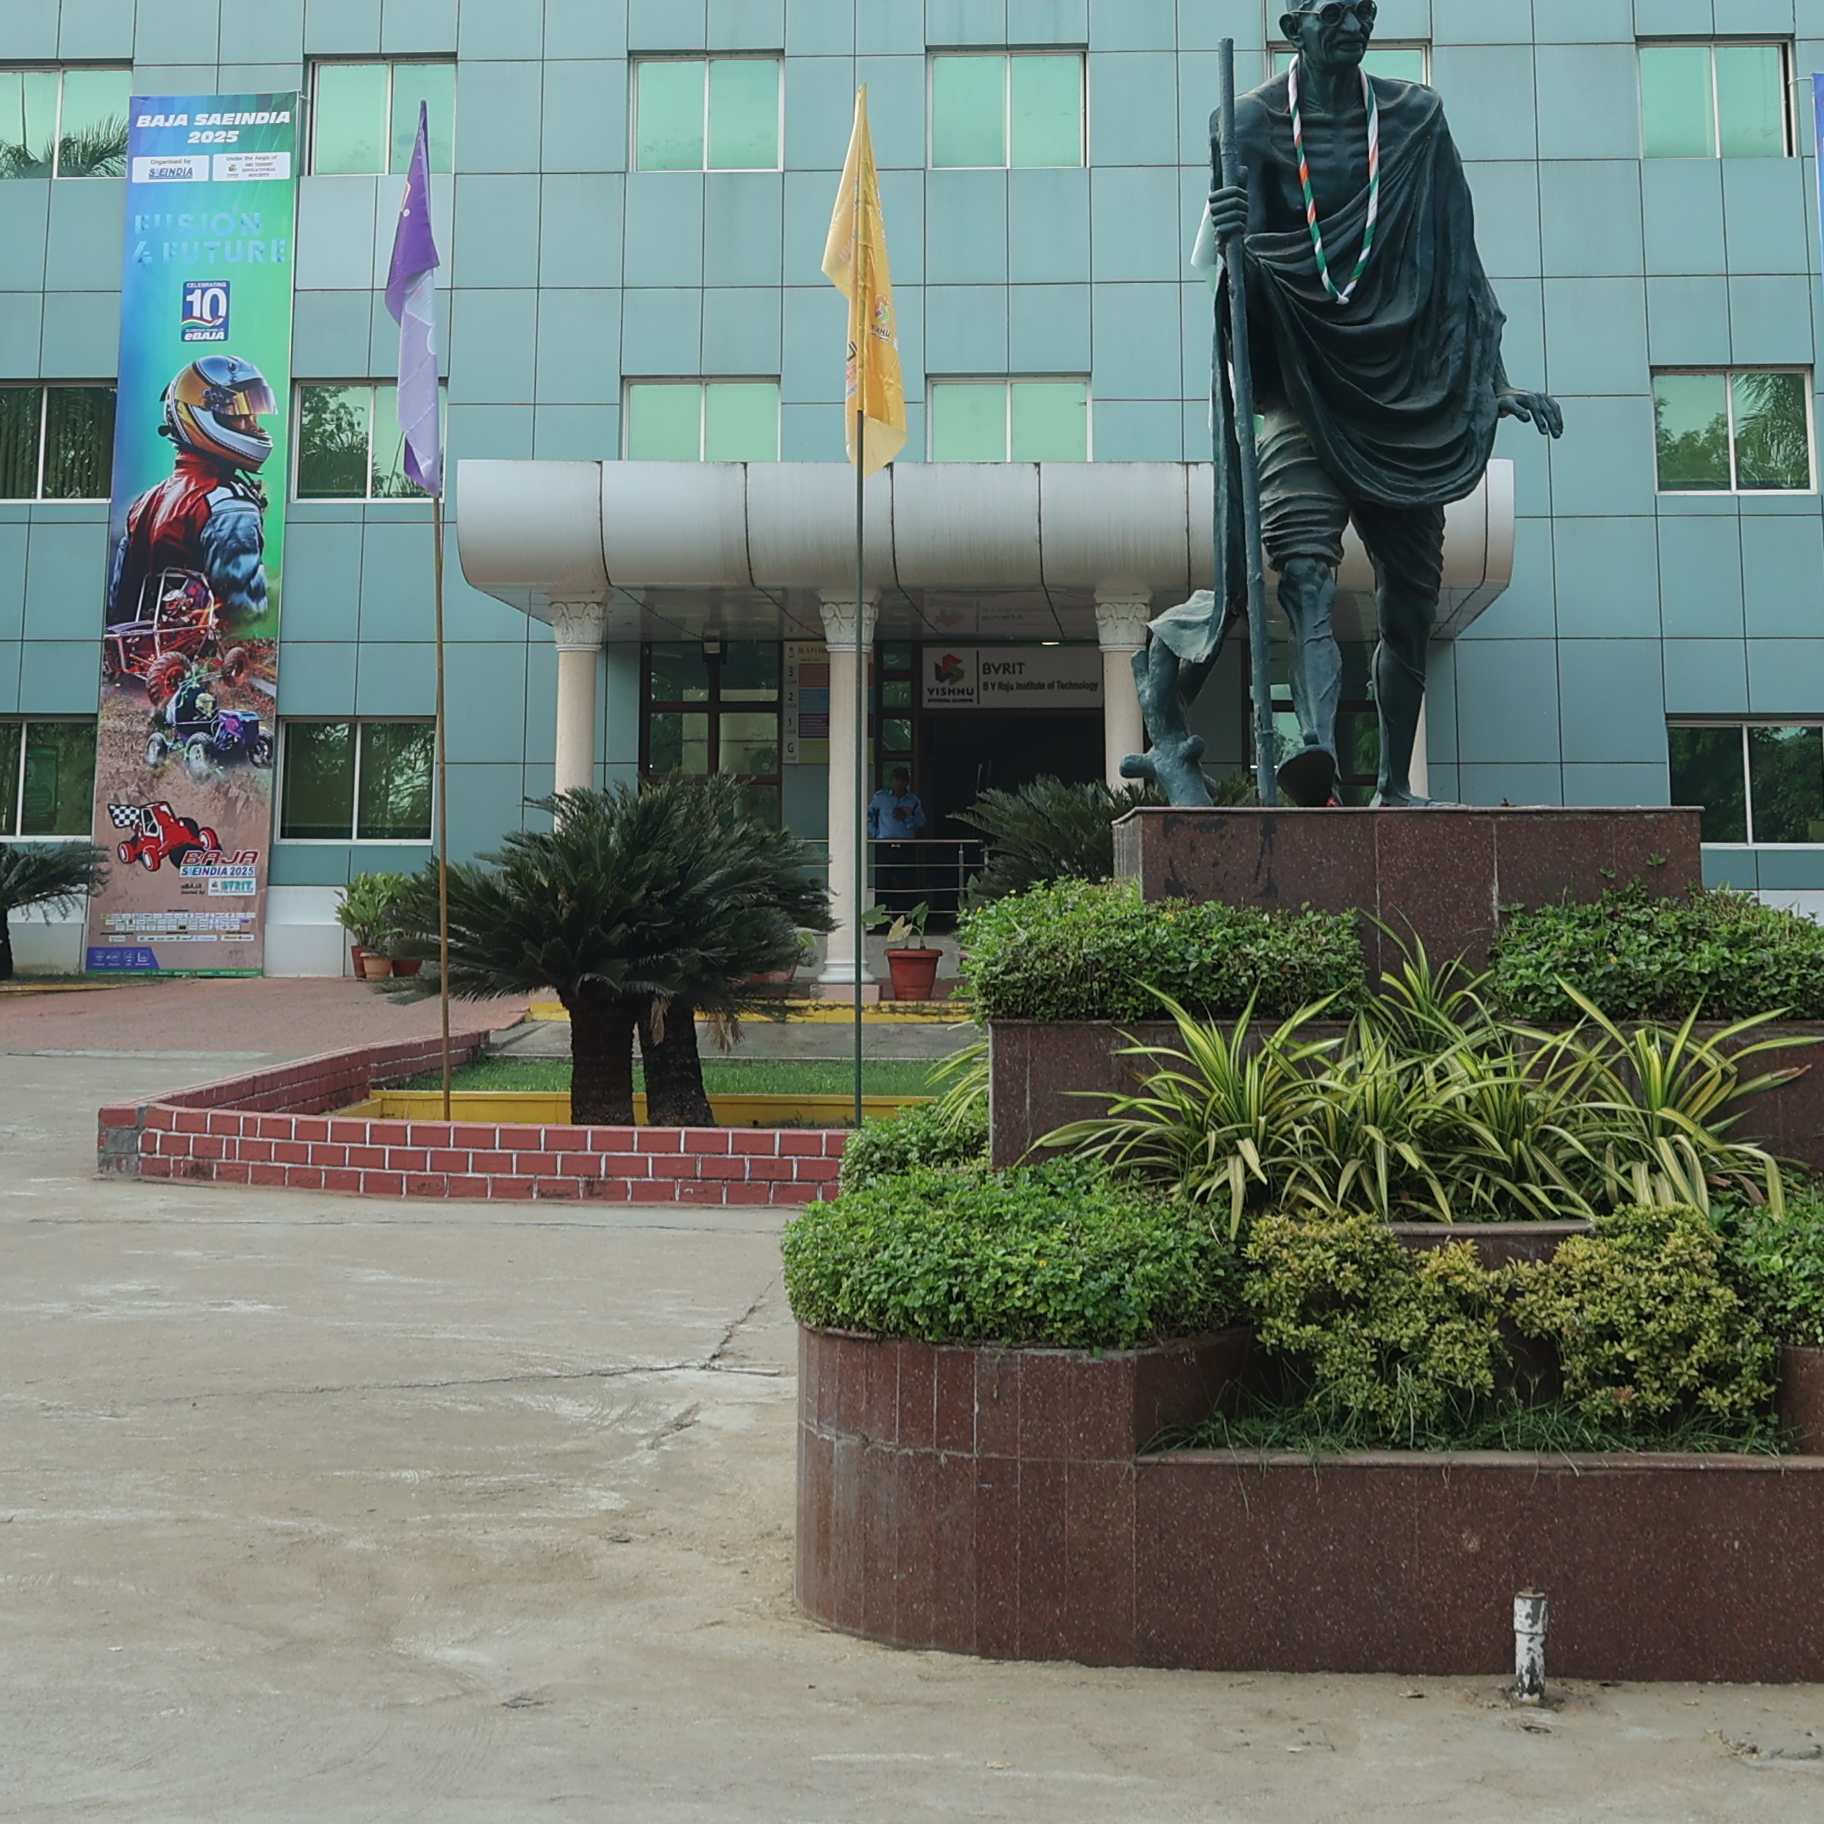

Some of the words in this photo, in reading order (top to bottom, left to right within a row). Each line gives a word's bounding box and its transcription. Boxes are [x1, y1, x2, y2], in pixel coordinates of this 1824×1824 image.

[136, 114, 188, 127] BAJA
[194, 112, 290, 125] SAEINDIA
[187, 130, 239, 143] 2025
[186, 288, 227, 320] 10
[184, 332, 225, 341] eBAJA
[789, 667, 793, 676] 3
[982, 662, 1025, 675] BVRIT
[927, 687, 974, 696] VISHNU
[983, 682, 988, 691] B
[990, 682, 996, 691] V
[998, 681, 1014, 693] Raju
[1016, 680, 1045, 691] Institute
[1047, 680, 1055, 690] of
[1056, 680, 1098, 691] Technology
[788, 693, 793, 701] 2
[787, 743, 794, 753] G
[181, 850, 260, 865] BAJA
[230, 867, 254, 875] 2025
